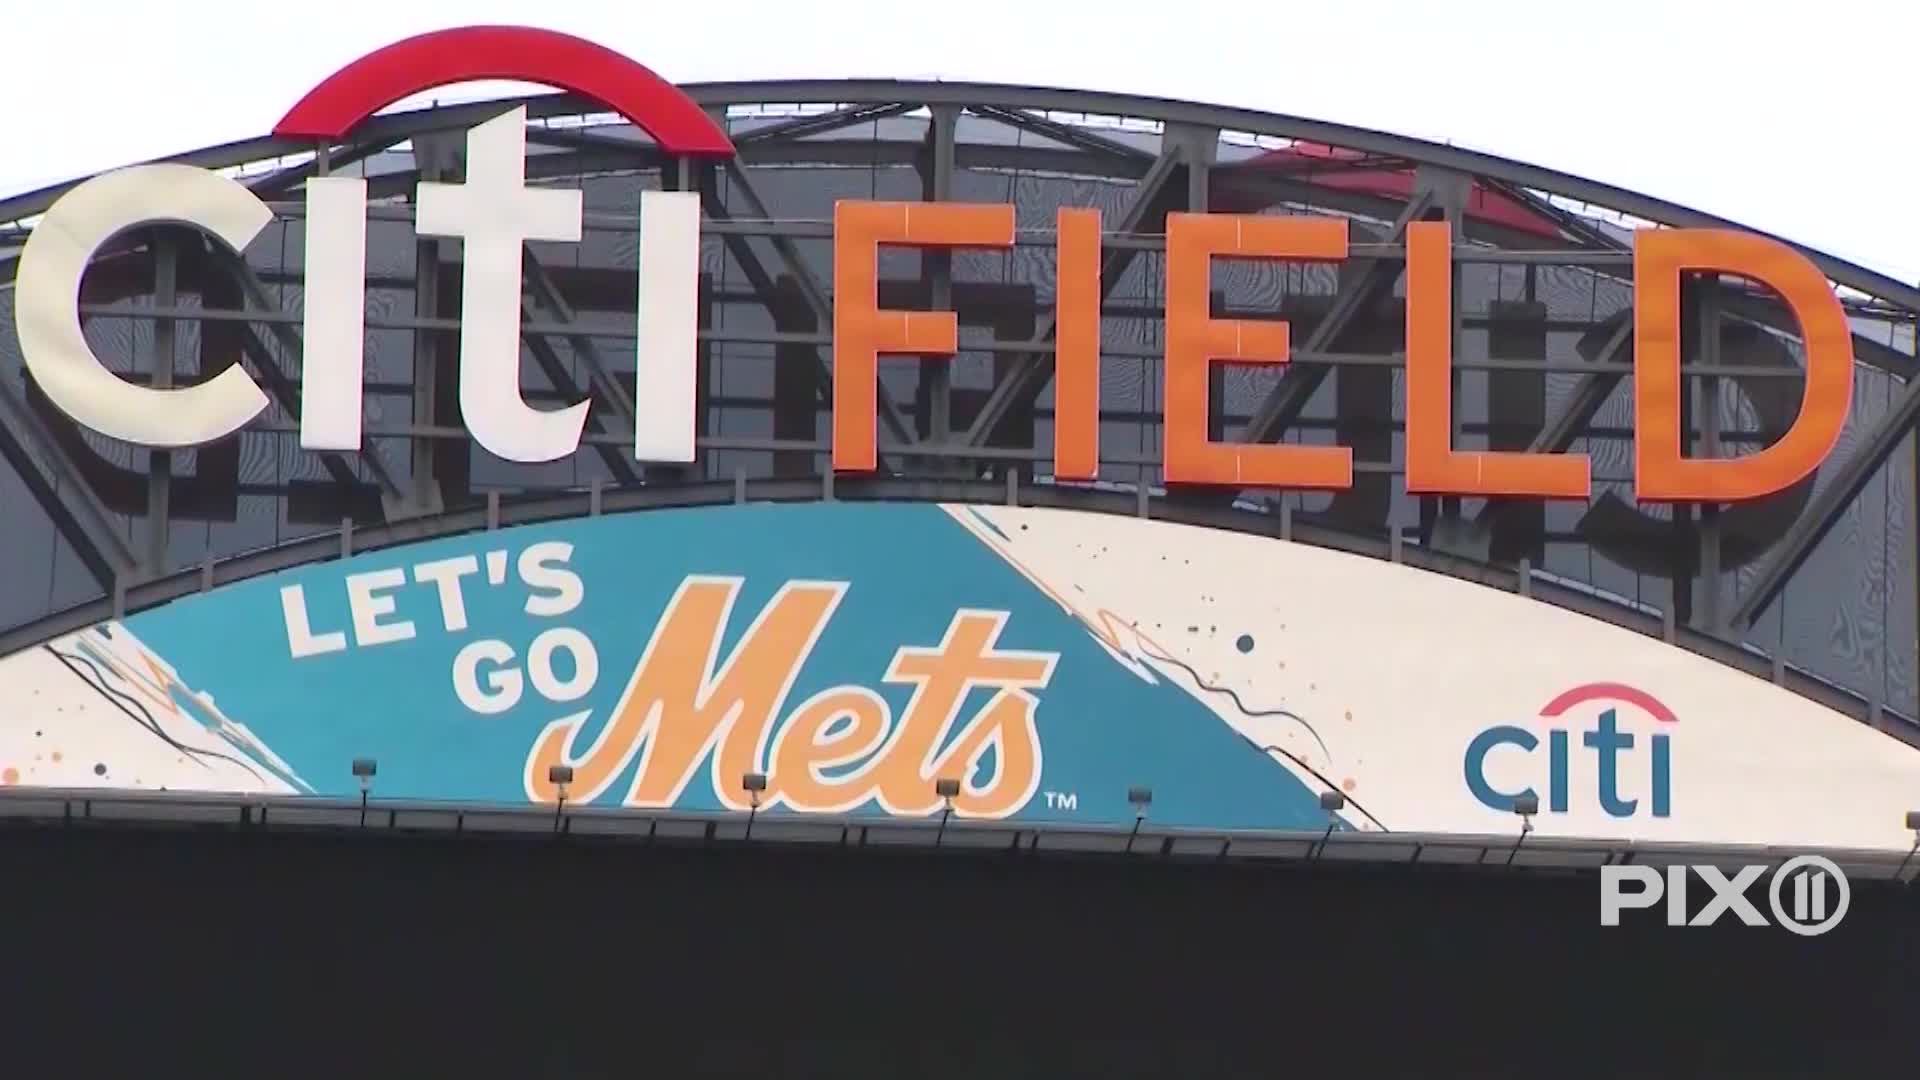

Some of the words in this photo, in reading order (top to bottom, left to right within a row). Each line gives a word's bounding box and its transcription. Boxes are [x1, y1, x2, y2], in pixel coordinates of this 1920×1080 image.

[15, 105, 702, 463] citi
[832, 201, 1855, 503] FIELD
[280, 541, 584, 658] LET'S
[452, 627, 599, 714] GO
[524, 574, 1061, 819] Mets
[1464, 707, 1671, 818] citi
